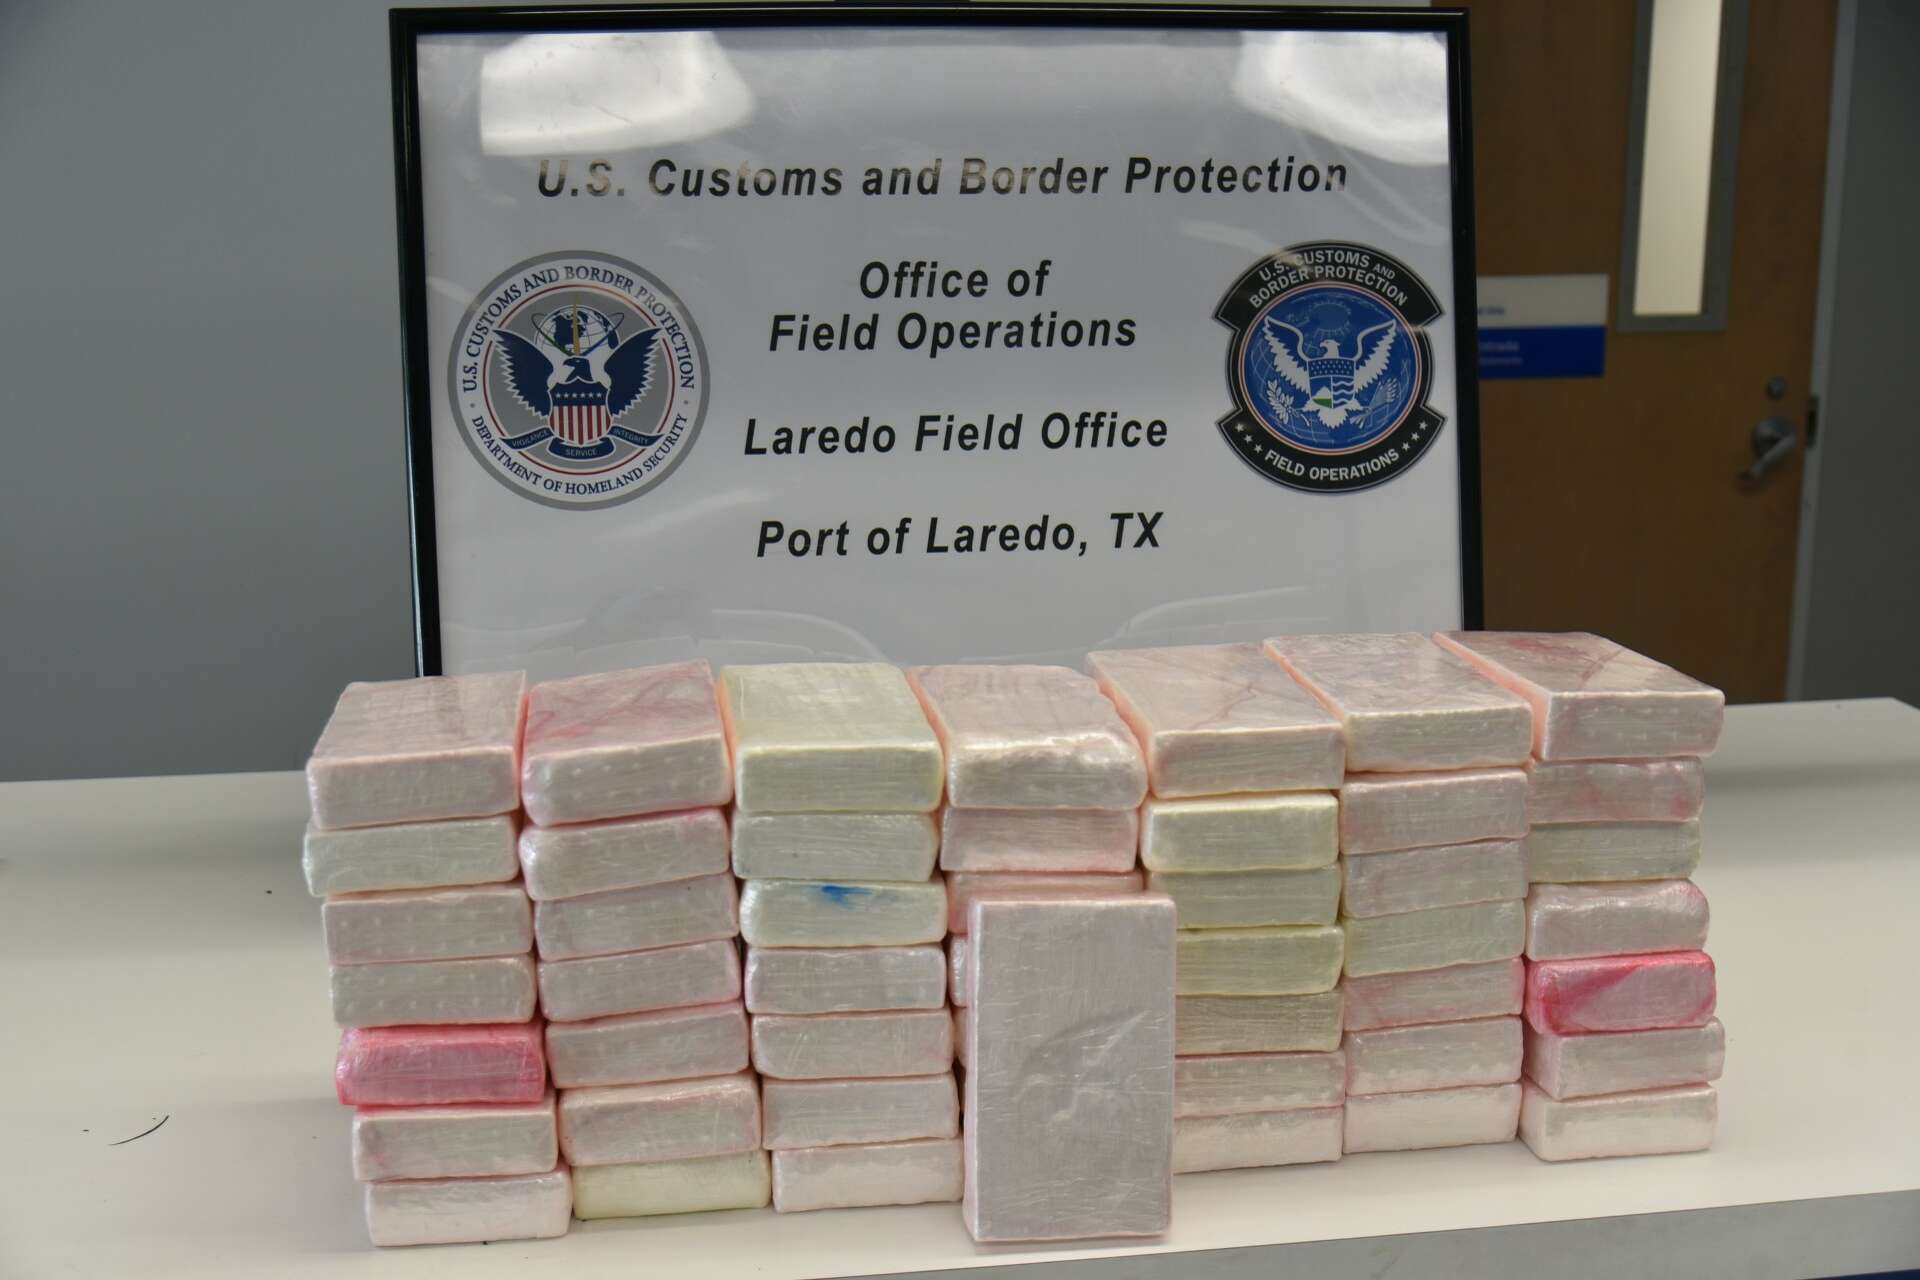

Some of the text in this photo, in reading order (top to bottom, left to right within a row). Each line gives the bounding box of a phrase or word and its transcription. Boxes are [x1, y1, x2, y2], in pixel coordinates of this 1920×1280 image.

[538, 156, 1348, 198] U.S. Customs and Border Protection
[860, 260, 1053, 300] Office of
[1250, 265, 1409, 308] BORDER PROTECTION
[1259, 250, 1396, 281] U.S. CUSTOMS AND
[463, 266, 695, 392] U.S. CUSTOMS AND BORDER PROTECTION
[769, 311, 1137, 360] Field Operations
[472, 414, 688, 495] DEPARTMENT OF HOMELAND SECURITY
[565, 449, 598, 457] SERVICE
[744, 411, 1168, 456] Laredo Field Office
[1264, 448, 1400, 481] FIELD OPERATIONS
[757, 512, 1165, 558] Port of Laredo, TX
